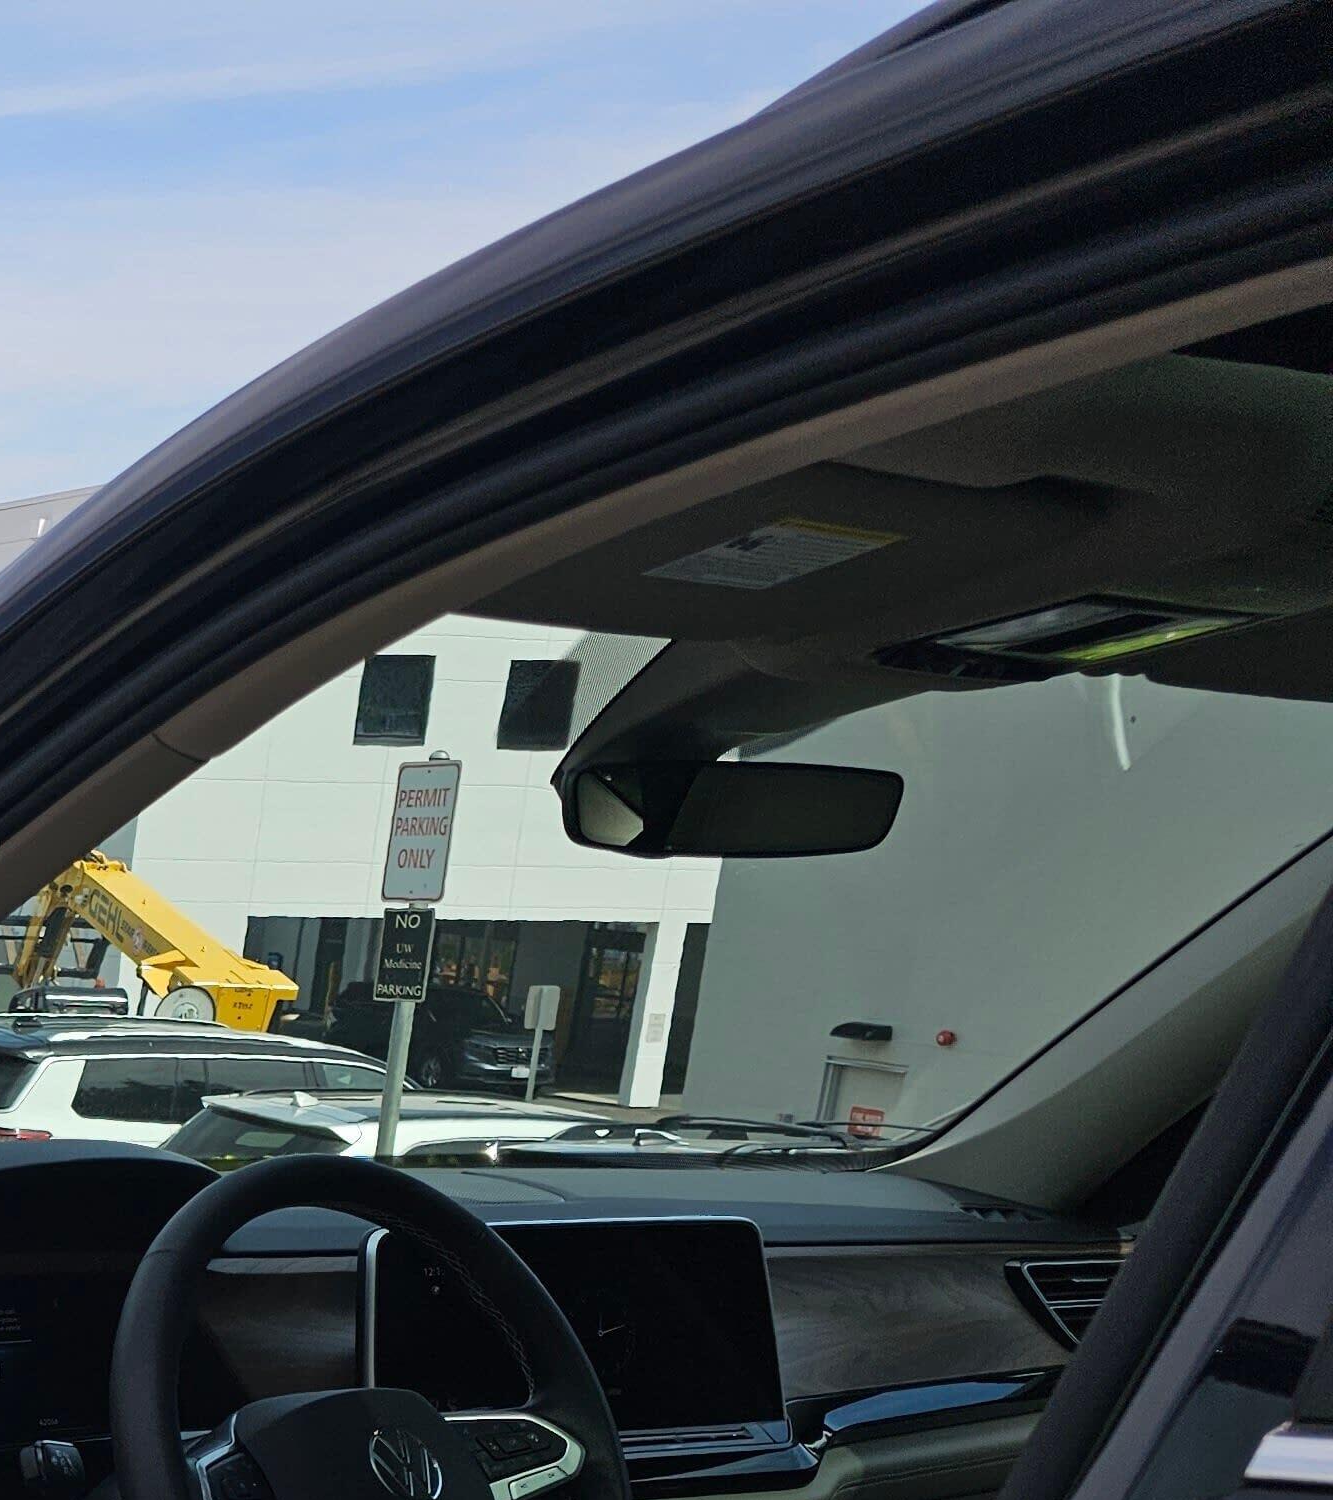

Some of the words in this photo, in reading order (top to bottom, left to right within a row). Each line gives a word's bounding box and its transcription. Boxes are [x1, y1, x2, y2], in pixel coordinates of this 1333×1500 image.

[398, 788, 451, 808] PERMIT
[394, 816, 448, 836] PARKING
[397, 848, 435, 868] ONLY
[87, 887, 124, 943] GEHL
[395, 914, 421, 929] NO
[396, 944, 414, 953] UW
[384, 958, 422, 970] Medicine
[376, 983, 422, 997] PARKING
